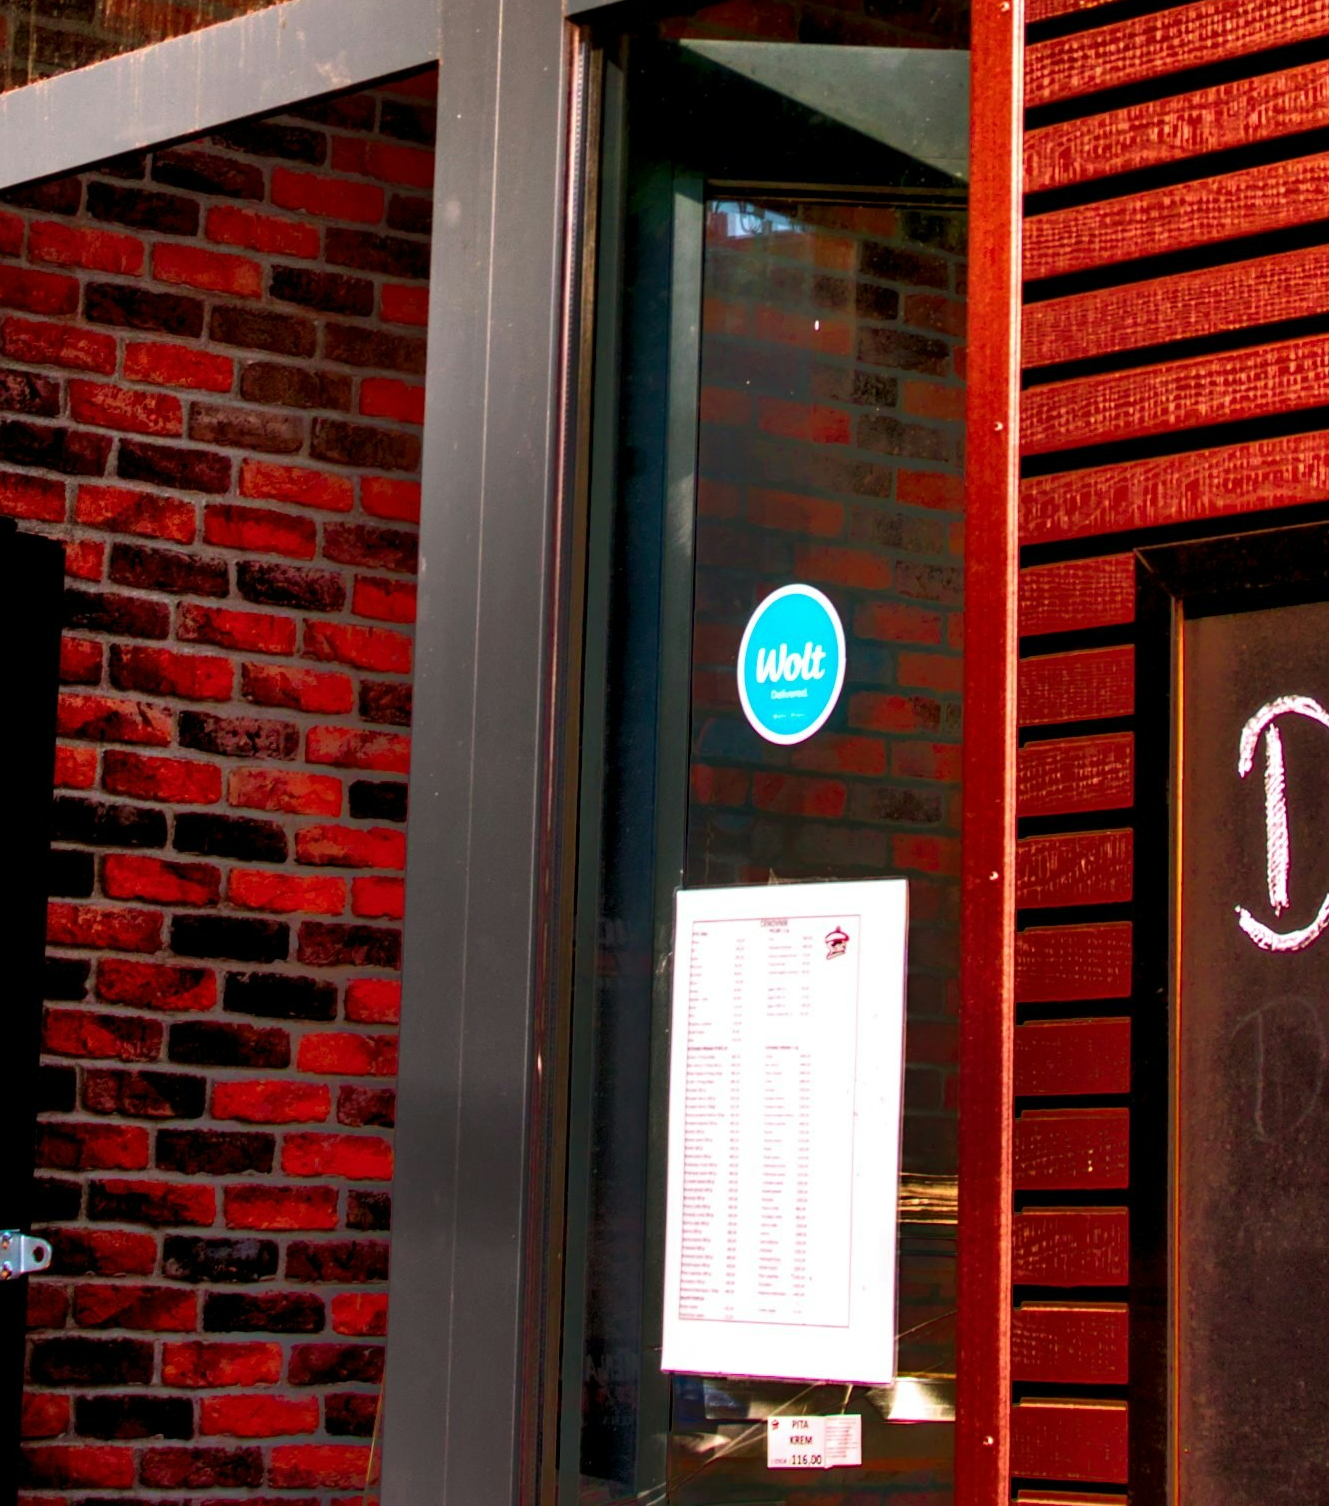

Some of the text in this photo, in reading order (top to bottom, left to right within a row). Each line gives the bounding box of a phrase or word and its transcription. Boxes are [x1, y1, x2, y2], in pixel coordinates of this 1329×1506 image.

[756, 641, 826, 683] Wolt
[792, 1419, 809, 1429] PITA
[789, 1435, 813, 1445] KREM
